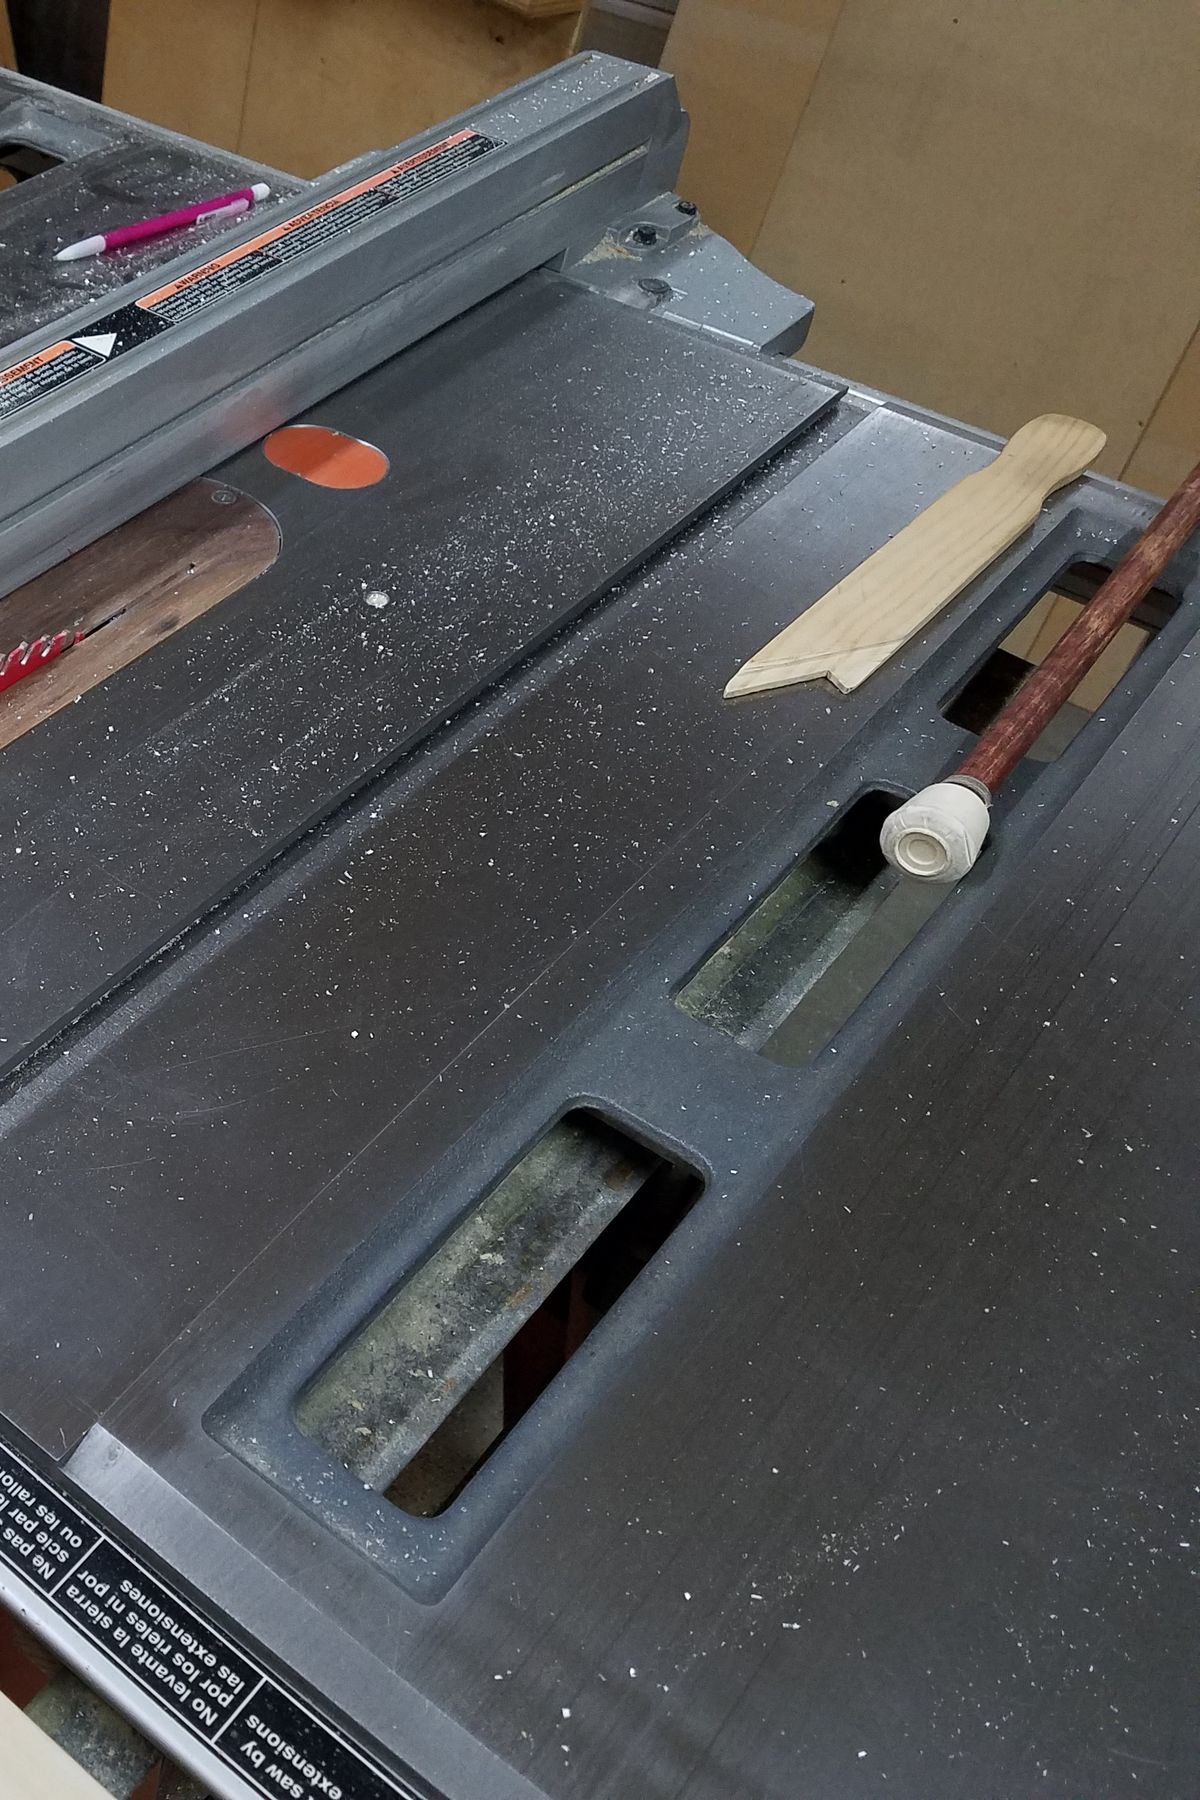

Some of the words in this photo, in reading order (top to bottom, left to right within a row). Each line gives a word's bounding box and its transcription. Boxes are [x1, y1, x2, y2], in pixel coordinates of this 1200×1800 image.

[8, 1509, 39, 1533] par
[36, 1505, 60, 1531] les
[3, 1528, 35, 1556] pas
[36, 1532, 69, 1562] scie
[60, 1527, 82, 1547] ou
[33, 1555, 55, 1580] Ne
[77, 1571, 110, 1597] por
[67, 1585, 112, 1628] sierra
[105, 1595, 125, 1613] ni
[120, 1580, 216, 1666] extensiones
[126, 1612, 171, 1654] rieles
[113, 1627, 130, 1648] la
[131, 1644, 191, 1702] levante
[173, 1653, 200, 1682] los
[218, 1666, 244, 1694] las
[199, 1679, 234, 1707] por
[192, 1698, 218, 1726] No
[240, 1741, 265, 1768] by
[246, 1715, 342, 1800] extensions
[265, 1764, 303, 1798] saw
